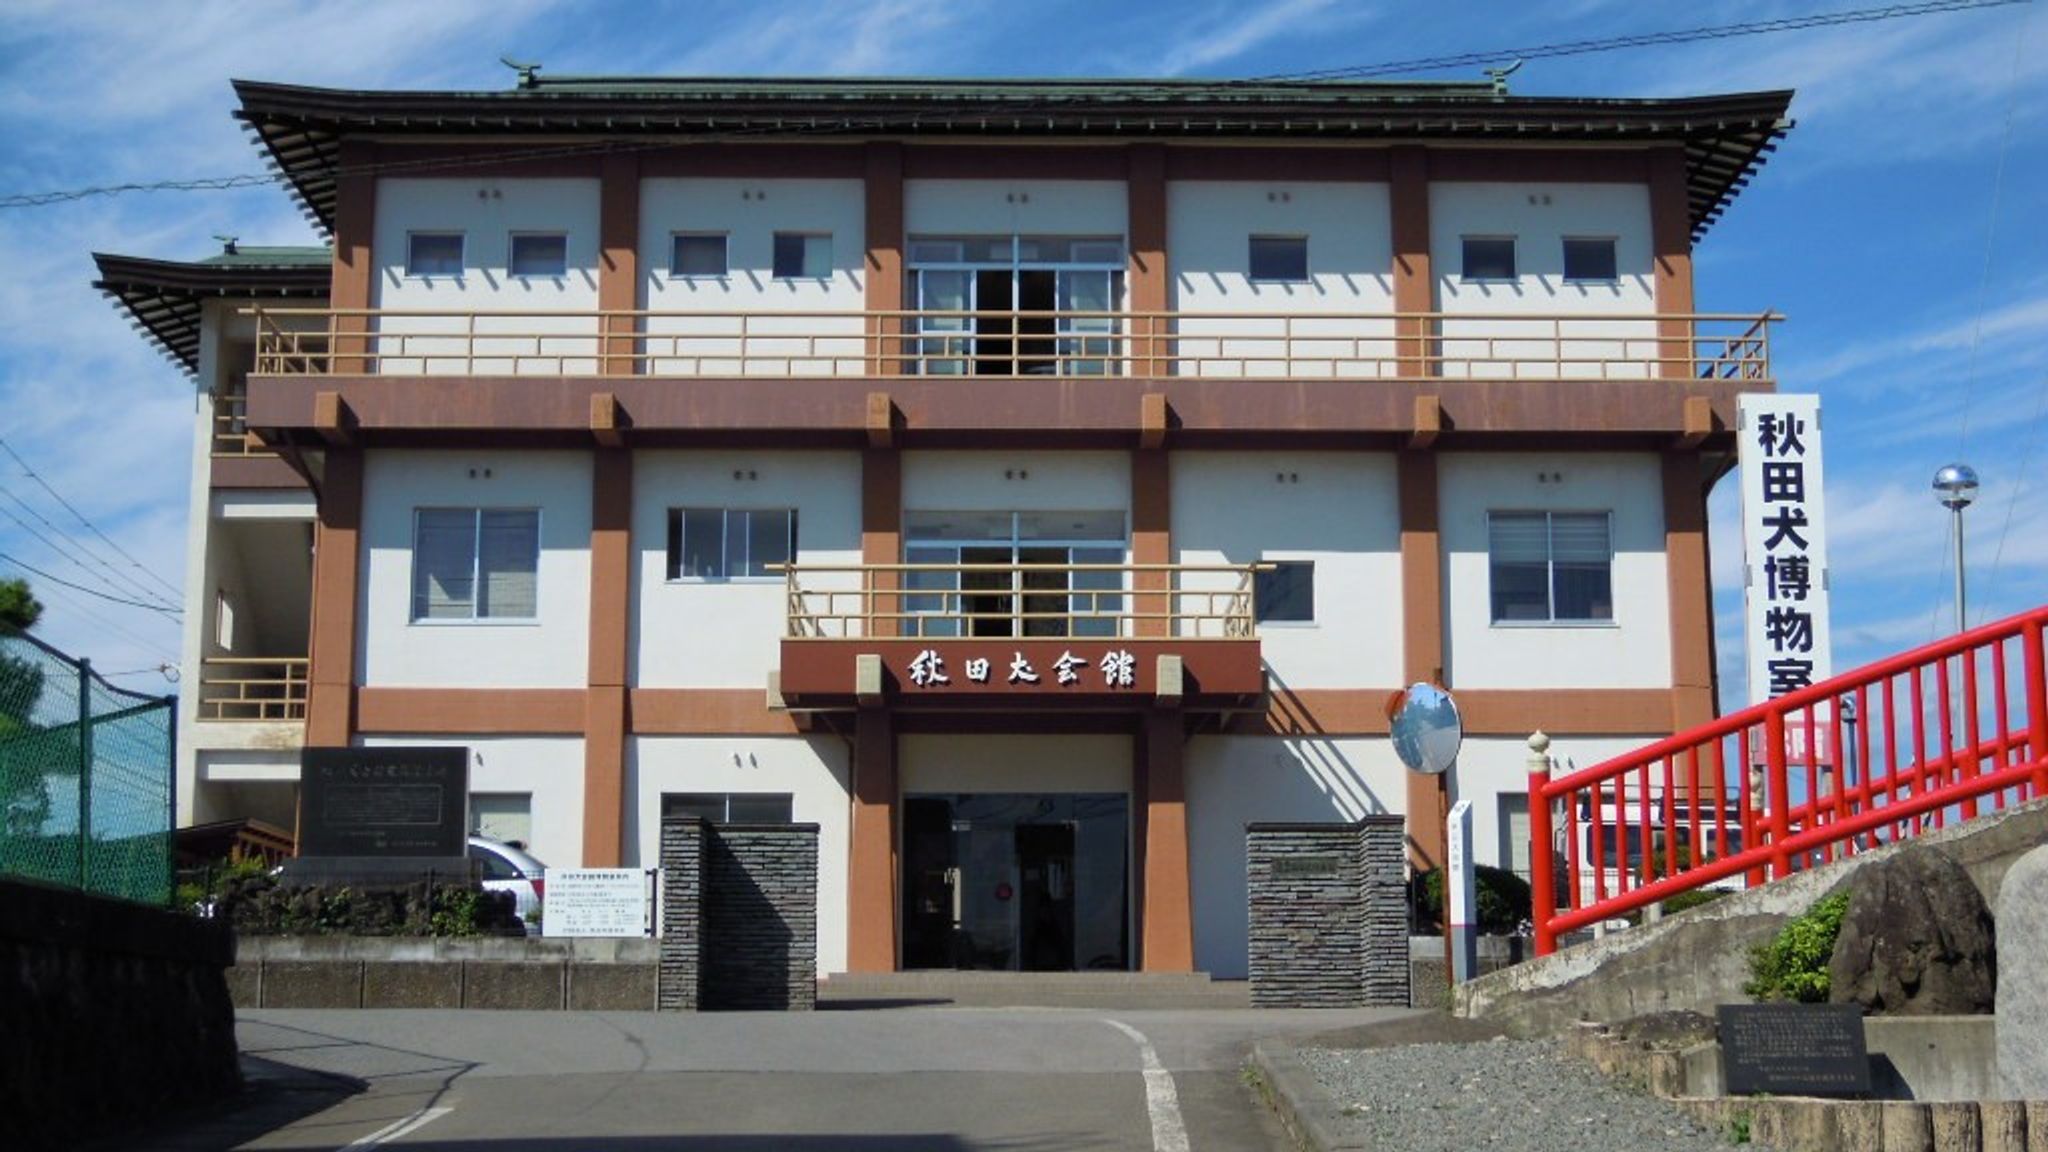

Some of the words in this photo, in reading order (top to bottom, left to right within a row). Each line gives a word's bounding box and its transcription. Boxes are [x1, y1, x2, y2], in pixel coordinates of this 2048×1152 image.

[1758, 412, 1813, 700] 秋田犬博物室
